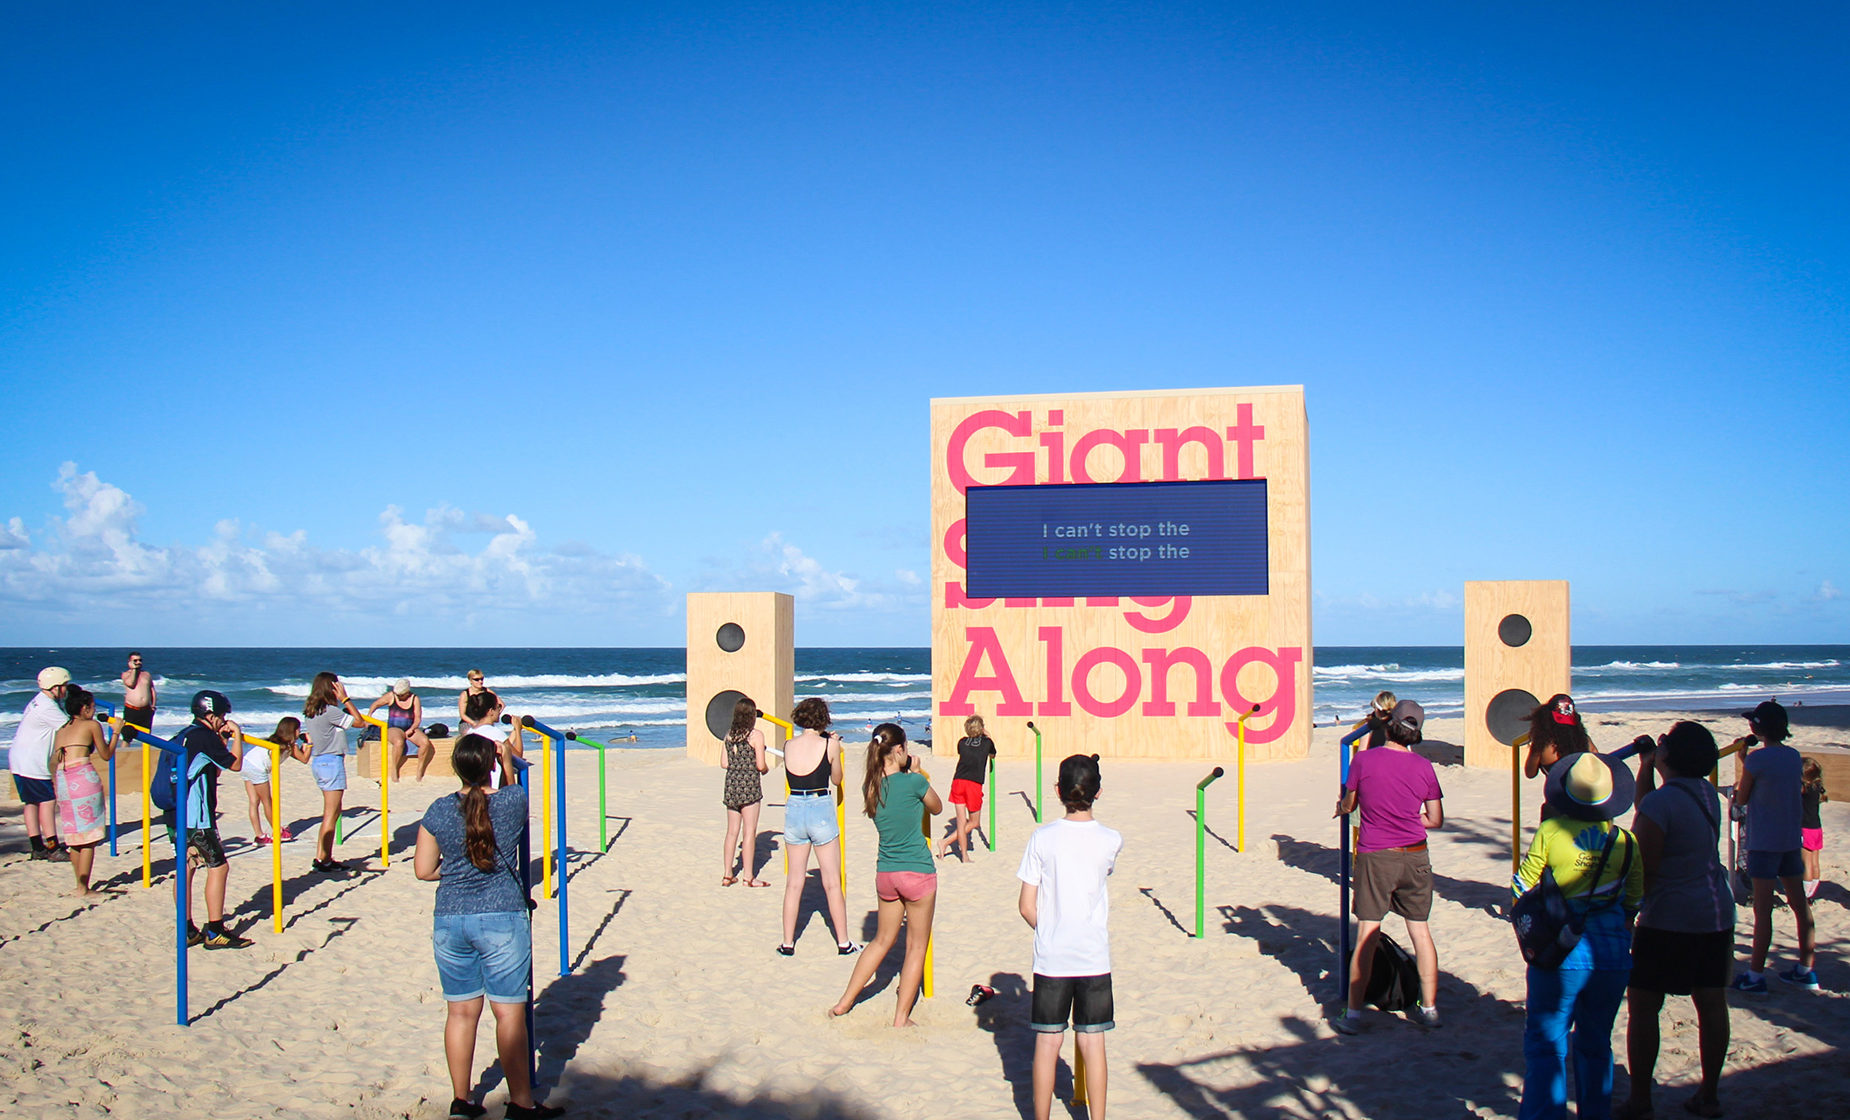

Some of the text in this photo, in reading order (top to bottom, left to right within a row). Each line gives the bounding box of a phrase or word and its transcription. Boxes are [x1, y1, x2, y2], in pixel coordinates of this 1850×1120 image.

[947, 403, 1265, 496] Giant
[1043, 524, 1048, 538] I
[1108, 522, 1151, 539] stop
[1158, 521, 1190, 536] the
[1043, 546, 1048, 560] I
[1108, 545, 1151, 562] stop
[1158, 544, 1190, 559] the
[939, 626, 1302, 745] Along
